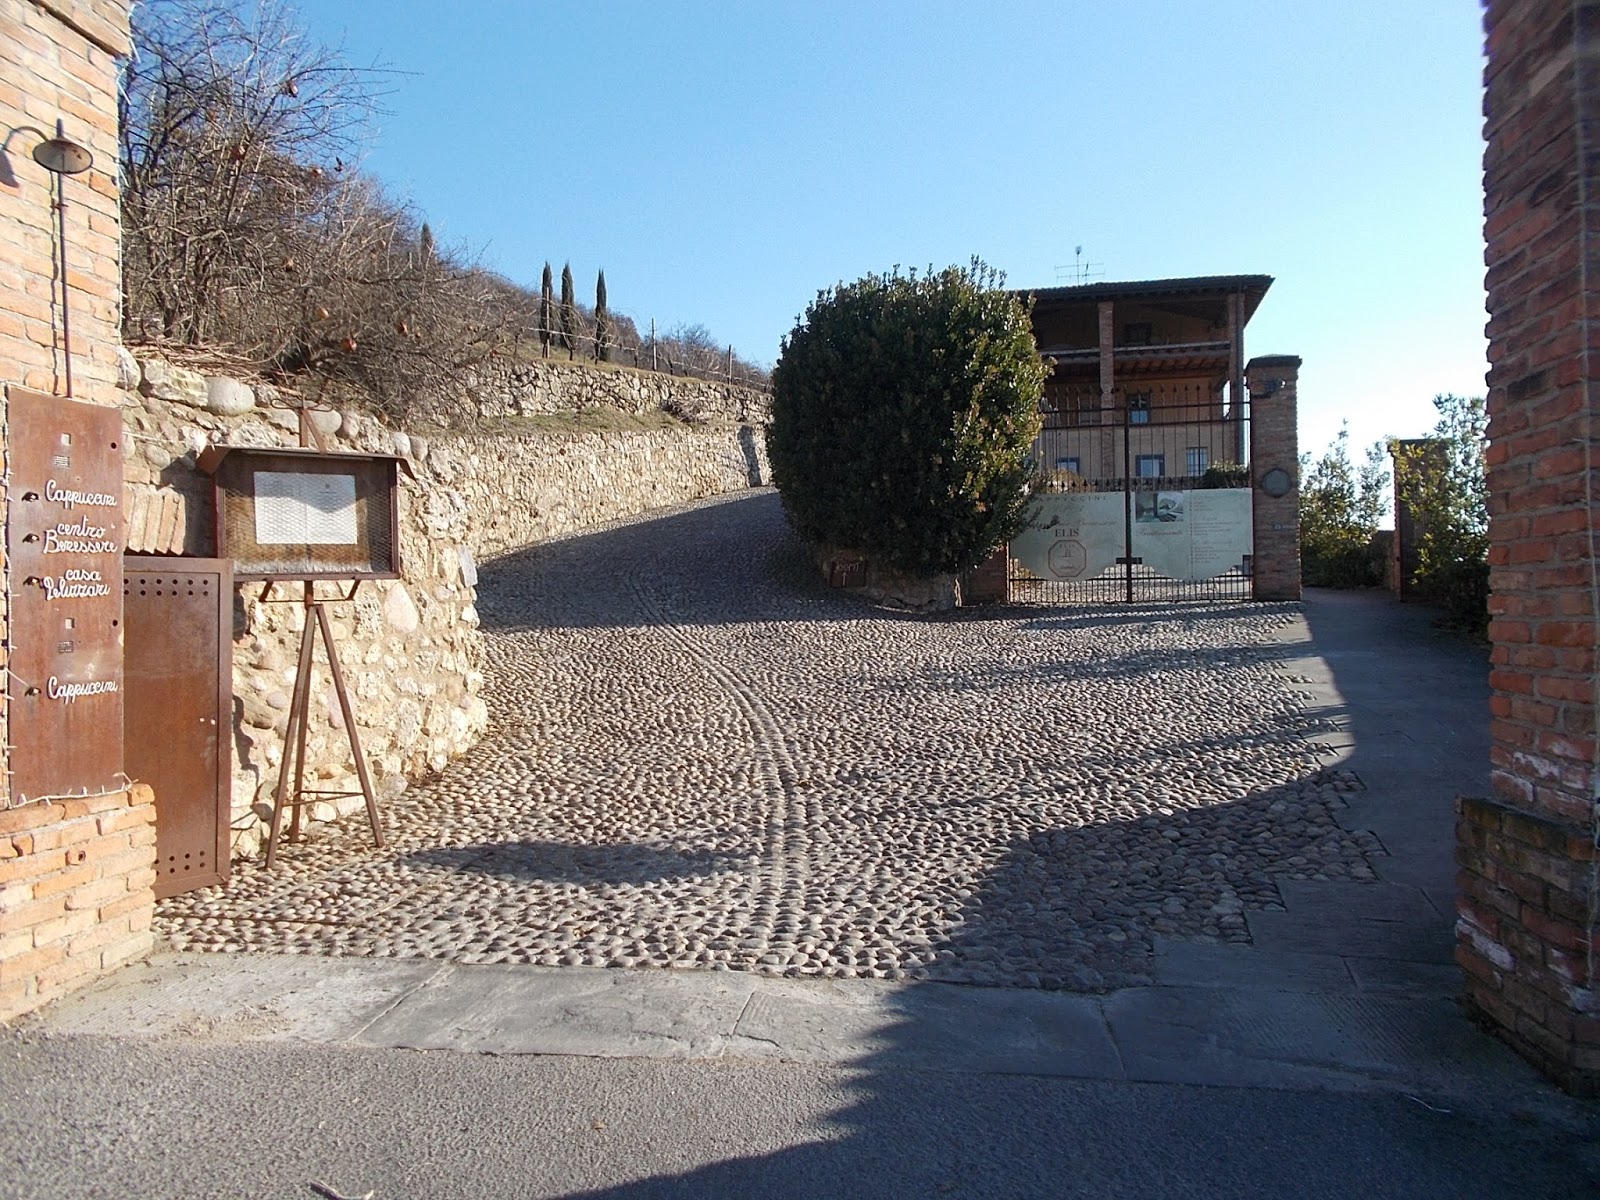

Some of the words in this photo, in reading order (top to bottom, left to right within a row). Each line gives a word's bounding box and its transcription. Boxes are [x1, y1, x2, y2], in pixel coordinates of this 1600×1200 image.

[57, 514, 106, 539] centro
[1055, 528, 1080, 537] ELIS
[43, 529, 119, 554] Benessere
[65, 568, 102, 582] casa
[48, 675, 119, 705] Cappuccini
